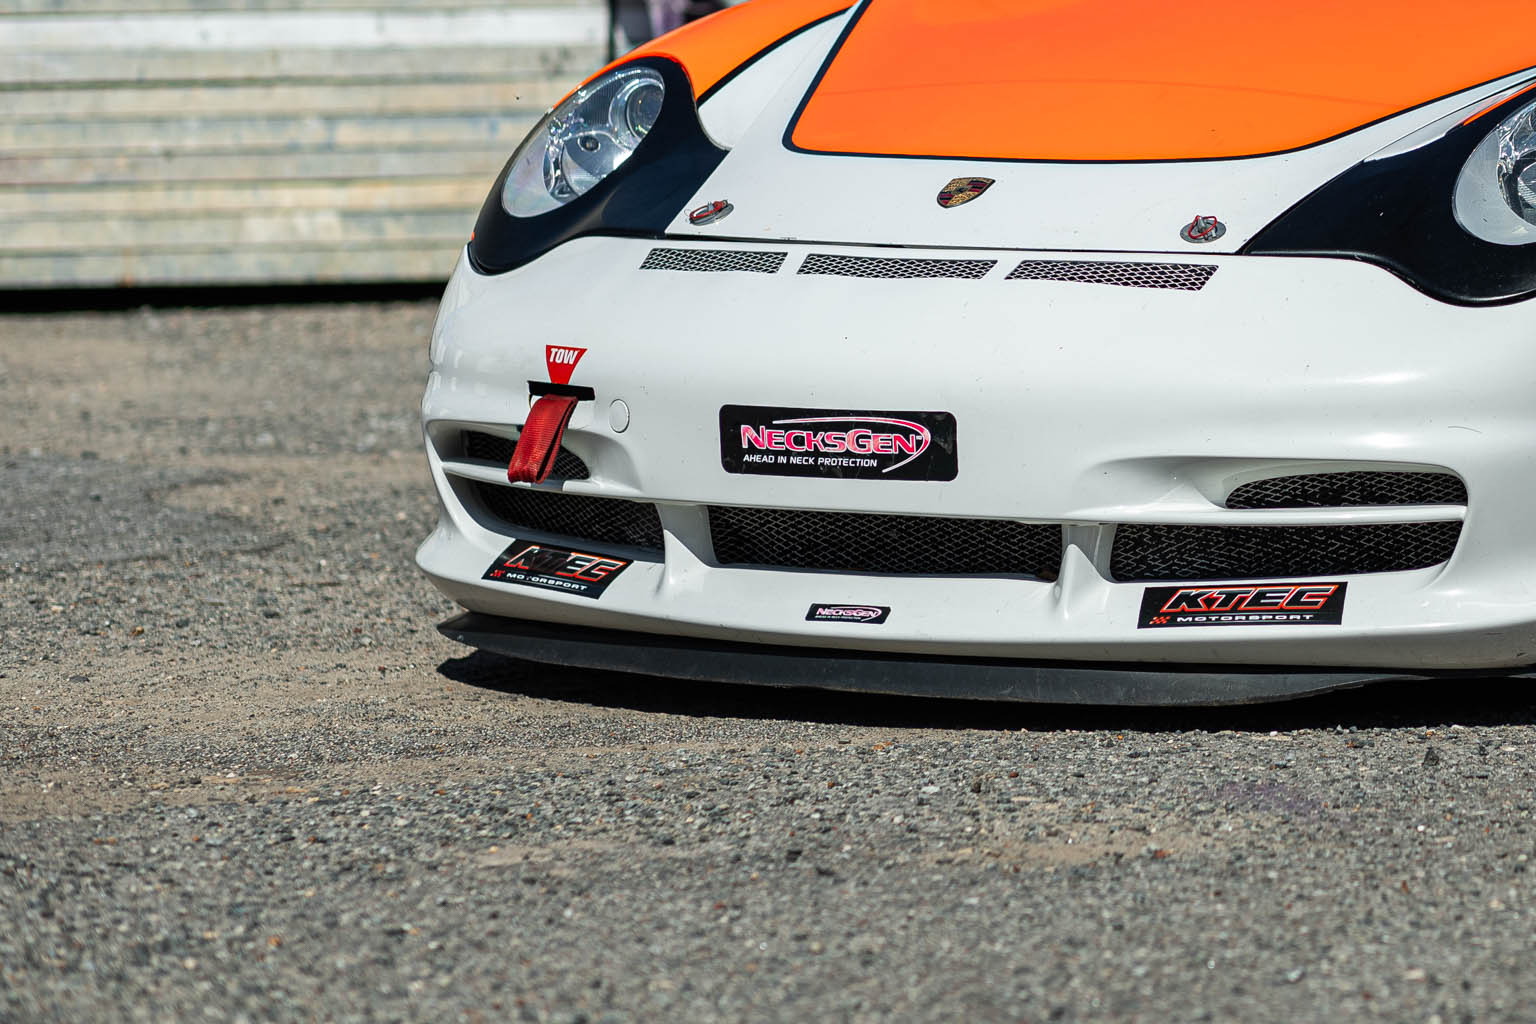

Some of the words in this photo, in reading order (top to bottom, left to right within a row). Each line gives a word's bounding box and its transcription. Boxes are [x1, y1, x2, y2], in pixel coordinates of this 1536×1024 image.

[550, 348, 580, 365] TOW
[743, 454, 775, 464] AHEAD
[777, 456, 787, 464] IN
[789, 456, 815, 465] NECK
[818, 457, 877, 467] PROTECTION
[503, 545, 628, 582] KEC
[1159, 584, 1340, 613] KTEC
[1176, 614, 1314, 623] MOTORSPORT
